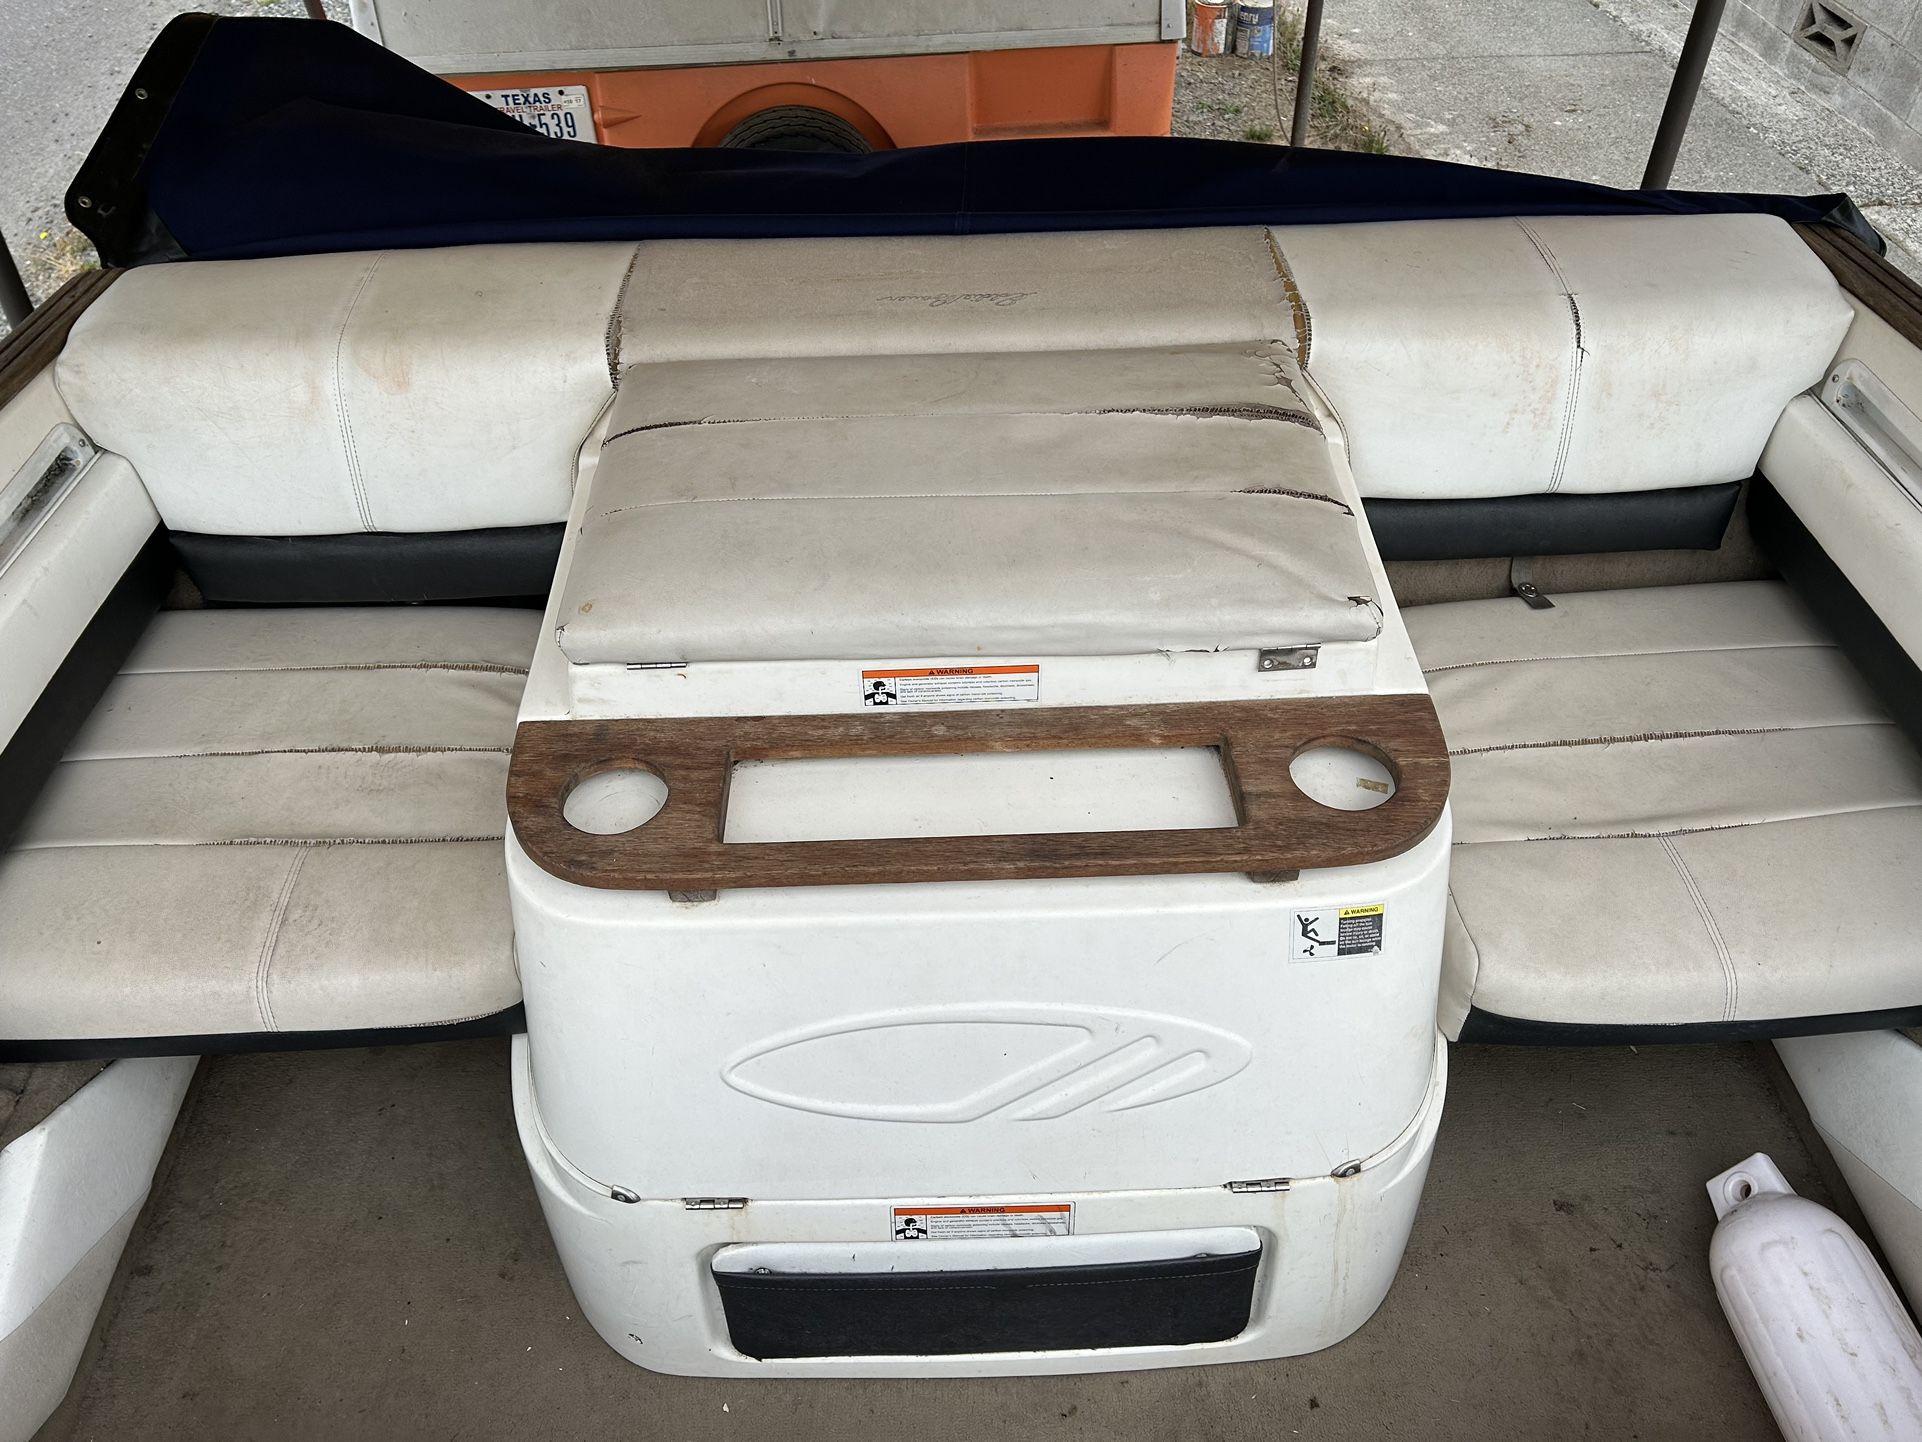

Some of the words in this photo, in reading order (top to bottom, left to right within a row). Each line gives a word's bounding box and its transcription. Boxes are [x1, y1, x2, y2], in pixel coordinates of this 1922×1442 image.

[1239, 11, 1259, 24] enry
[501, 92, 552, 106] TEXAS
[498, 105, 526, 114] RAVEL
[528, 104, 563, 112] TRAILER
[936, 668, 974, 676] WARNING
[1351, 907, 1378, 915] WARNING
[967, 1206, 1006, 1214] WARNING
